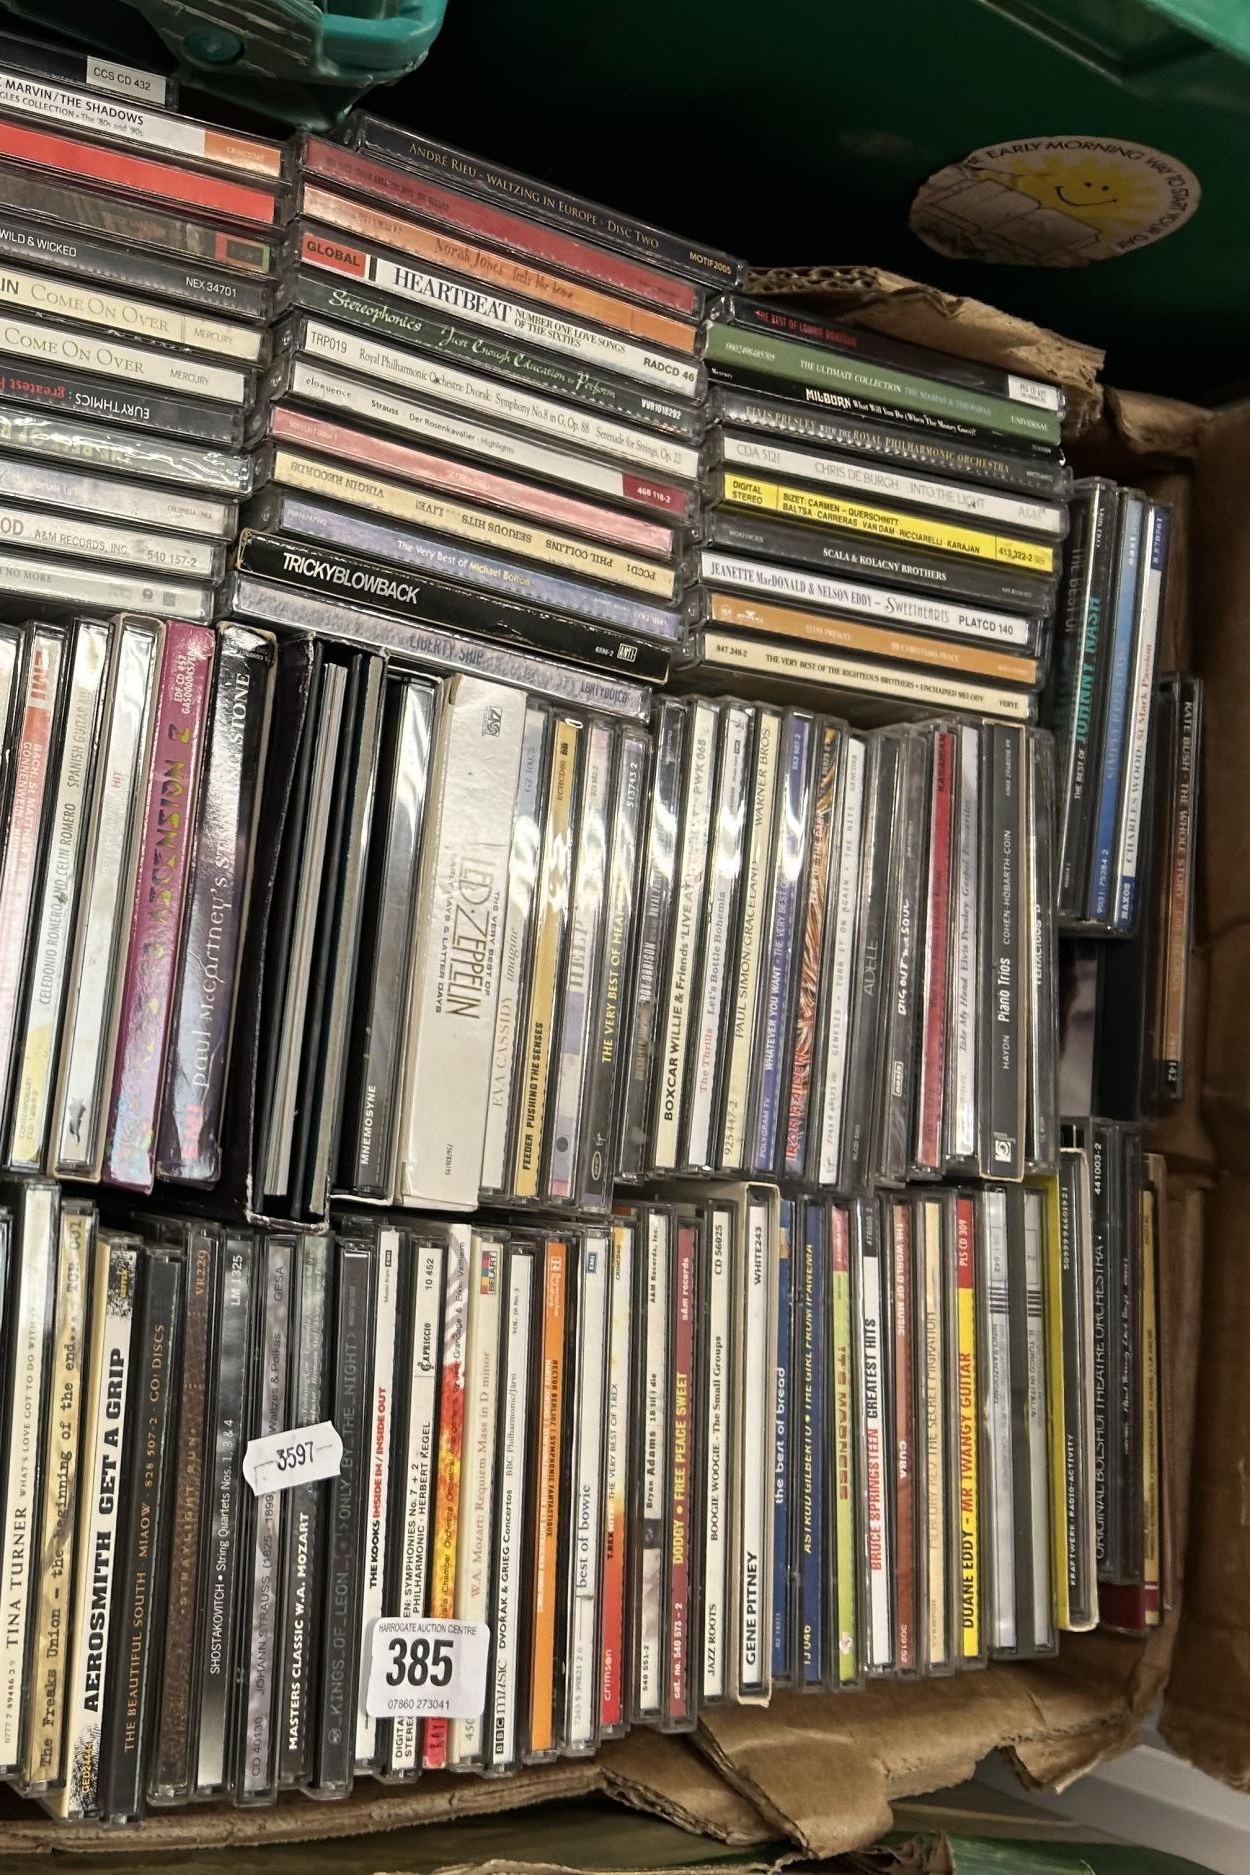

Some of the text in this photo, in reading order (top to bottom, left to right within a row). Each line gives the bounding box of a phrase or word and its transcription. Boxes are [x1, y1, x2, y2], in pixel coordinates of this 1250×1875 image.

[84, 101, 144, 126] SHADOWS
[37, 237, 77, 258] WICKED
[306, 238, 360, 268] GLOBAL
[392, 265, 513, 324] HEARTBEAT
[10, 376, 66, 400] greatest
[643, 355, 695, 383] RADCD 46
[74, 392, 150, 420] EURYTHMICS
[371, 400, 399, 415] Strauss
[732, 490, 763, 506] STEREO
[733, 479, 761, 496] DIGITAL
[823, 547, 849, 562] SCALA
[902, 563, 947, 582] BROTHERS
[849, 590, 873, 606] EDDY
[958, 614, 1014, 636] PLATCD 140
[227, 672, 250, 749] STONE
[997, 983, 1011, 1023] Piano
[1001, 1034, 1010, 1070] HAYDN
[526, 1084, 539, 1129] PUSHING
[664, 1058, 679, 1122] BOXCAR
[522, 1133, 534, 1171] FEEDER
[753, 1225, 764, 1285] WHITE243
[675, 1372, 687, 1459] PEACE SWEET
[959, 1352, 973, 1484] TWANGY GUITAR
[276, 1441, 315, 1472] 3597
[865, 1317, 882, 1571] BRUCE SPRINGSTEEN GREATEST HITS
[83, 1348, 126, 1712] AEROSMITH GET A GRIP
[298, 1511, 309, 1579] MOZART
[370, 1520, 381, 1564] KOOKS
[672, 1520, 684, 1564] DODGY
[5, 1506, 28, 1650] TINA TURNER
[962, 1527, 975, 1630] DUANE EDDY
[209, 1583, 226, 1675] SHOSTAKOVITCH
[418, 1622, 447, 1635] AUCTION
[745, 1553, 758, 1666] GENE PITNEY
[292, 1621, 305, 1681] CLASSIC
[386, 1637, 454, 1688] 385
[288, 1684, 302, 1751] MASTERS
[388, 1698, 450, 1711] 07860 273041
